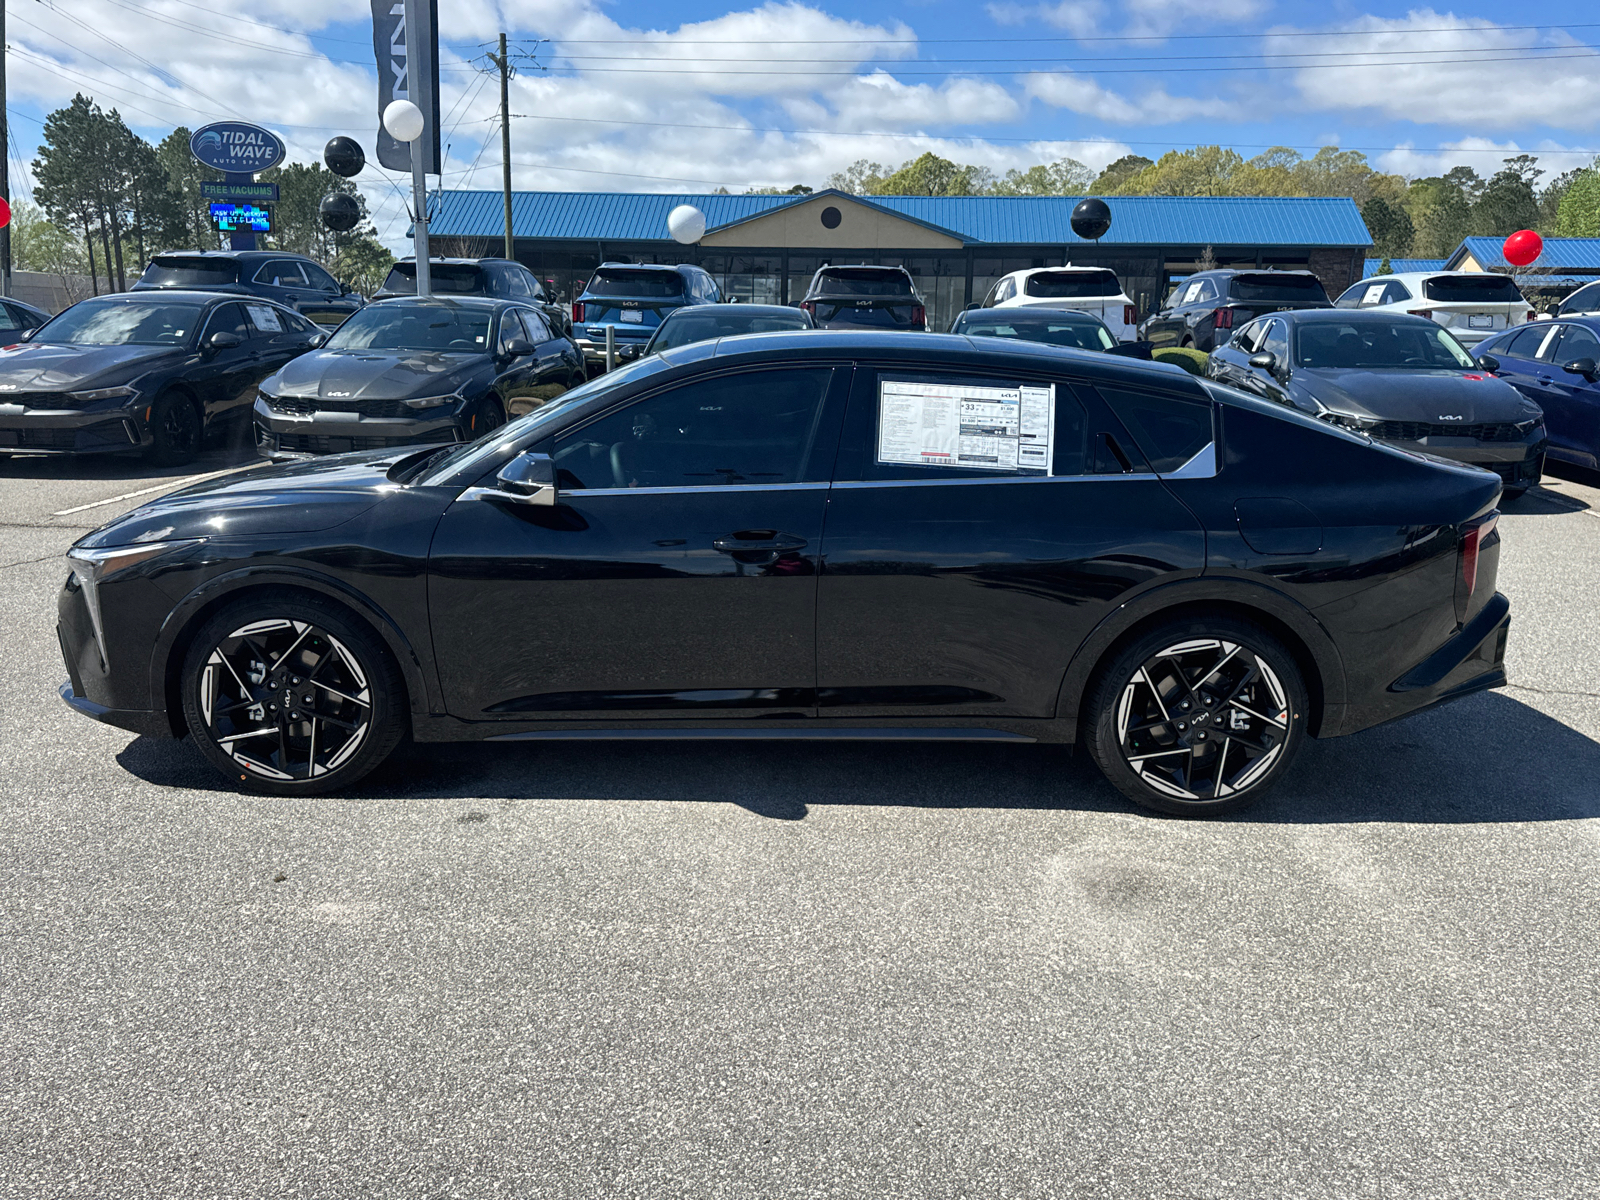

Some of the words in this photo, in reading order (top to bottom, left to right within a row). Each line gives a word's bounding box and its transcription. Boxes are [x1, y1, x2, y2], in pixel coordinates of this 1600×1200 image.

[222, 131, 264, 145] TIDAL
[229, 145, 274, 159] WAVE
[204, 185, 228, 194] FREE
[229, 185, 273, 196] VACUUMS
[965, 403, 975, 411] 33
[1103, 666, 1128, 713] KUMHO
[284, 689, 292, 708] KIA
[187, 702, 213, 751] KUMHO
